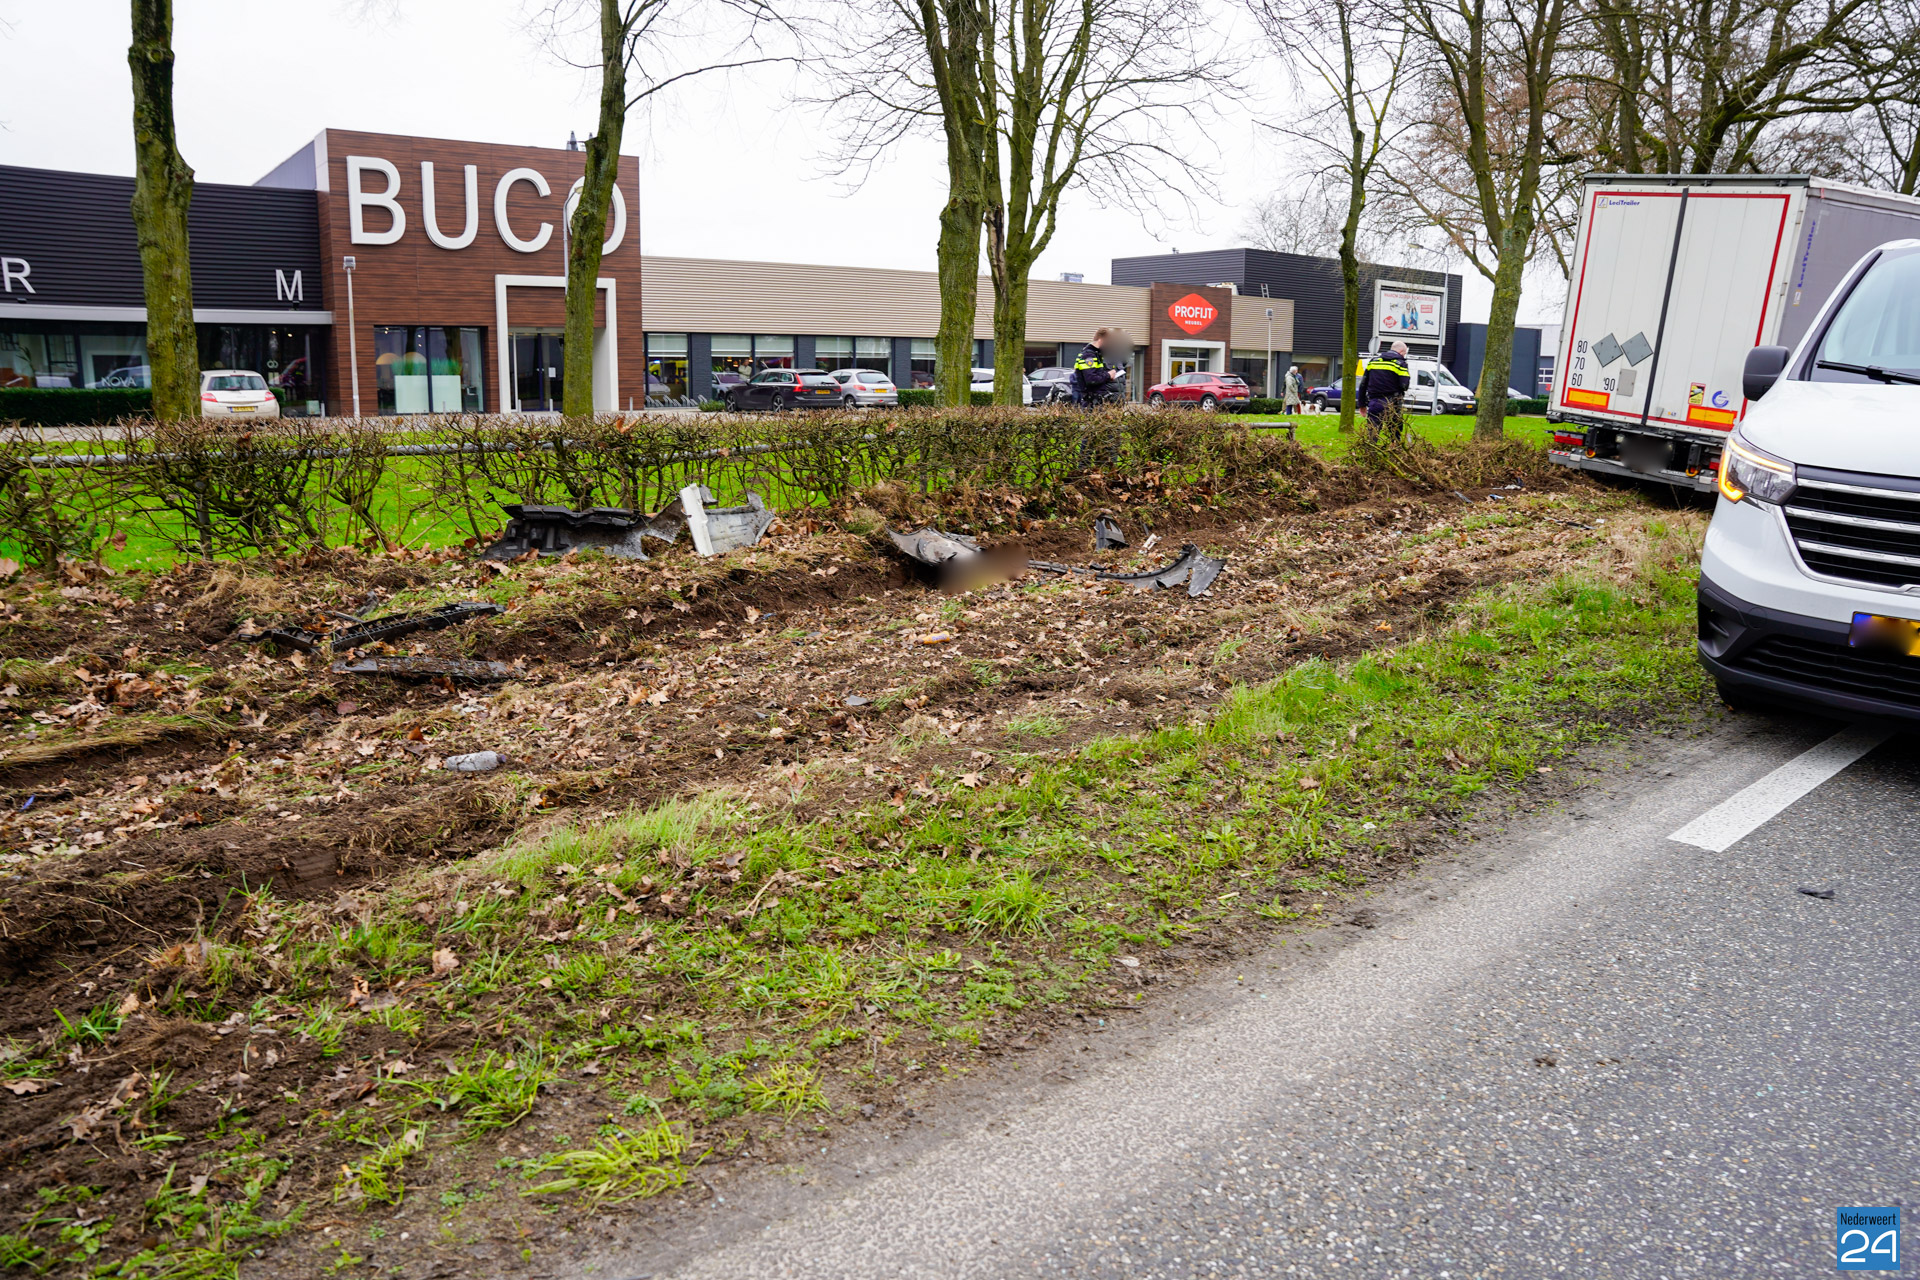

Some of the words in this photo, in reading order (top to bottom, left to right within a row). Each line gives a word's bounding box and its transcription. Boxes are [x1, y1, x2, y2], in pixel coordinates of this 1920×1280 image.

[346, 155, 627, 255] BUCO
[1174, 305, 1213, 319] PROFIJT
[1577, 340, 1588, 353] 80
[1574, 356, 1585, 370] 70
[101, 376, 137, 387] NOVA
[1571, 373, 1582, 386] 60
